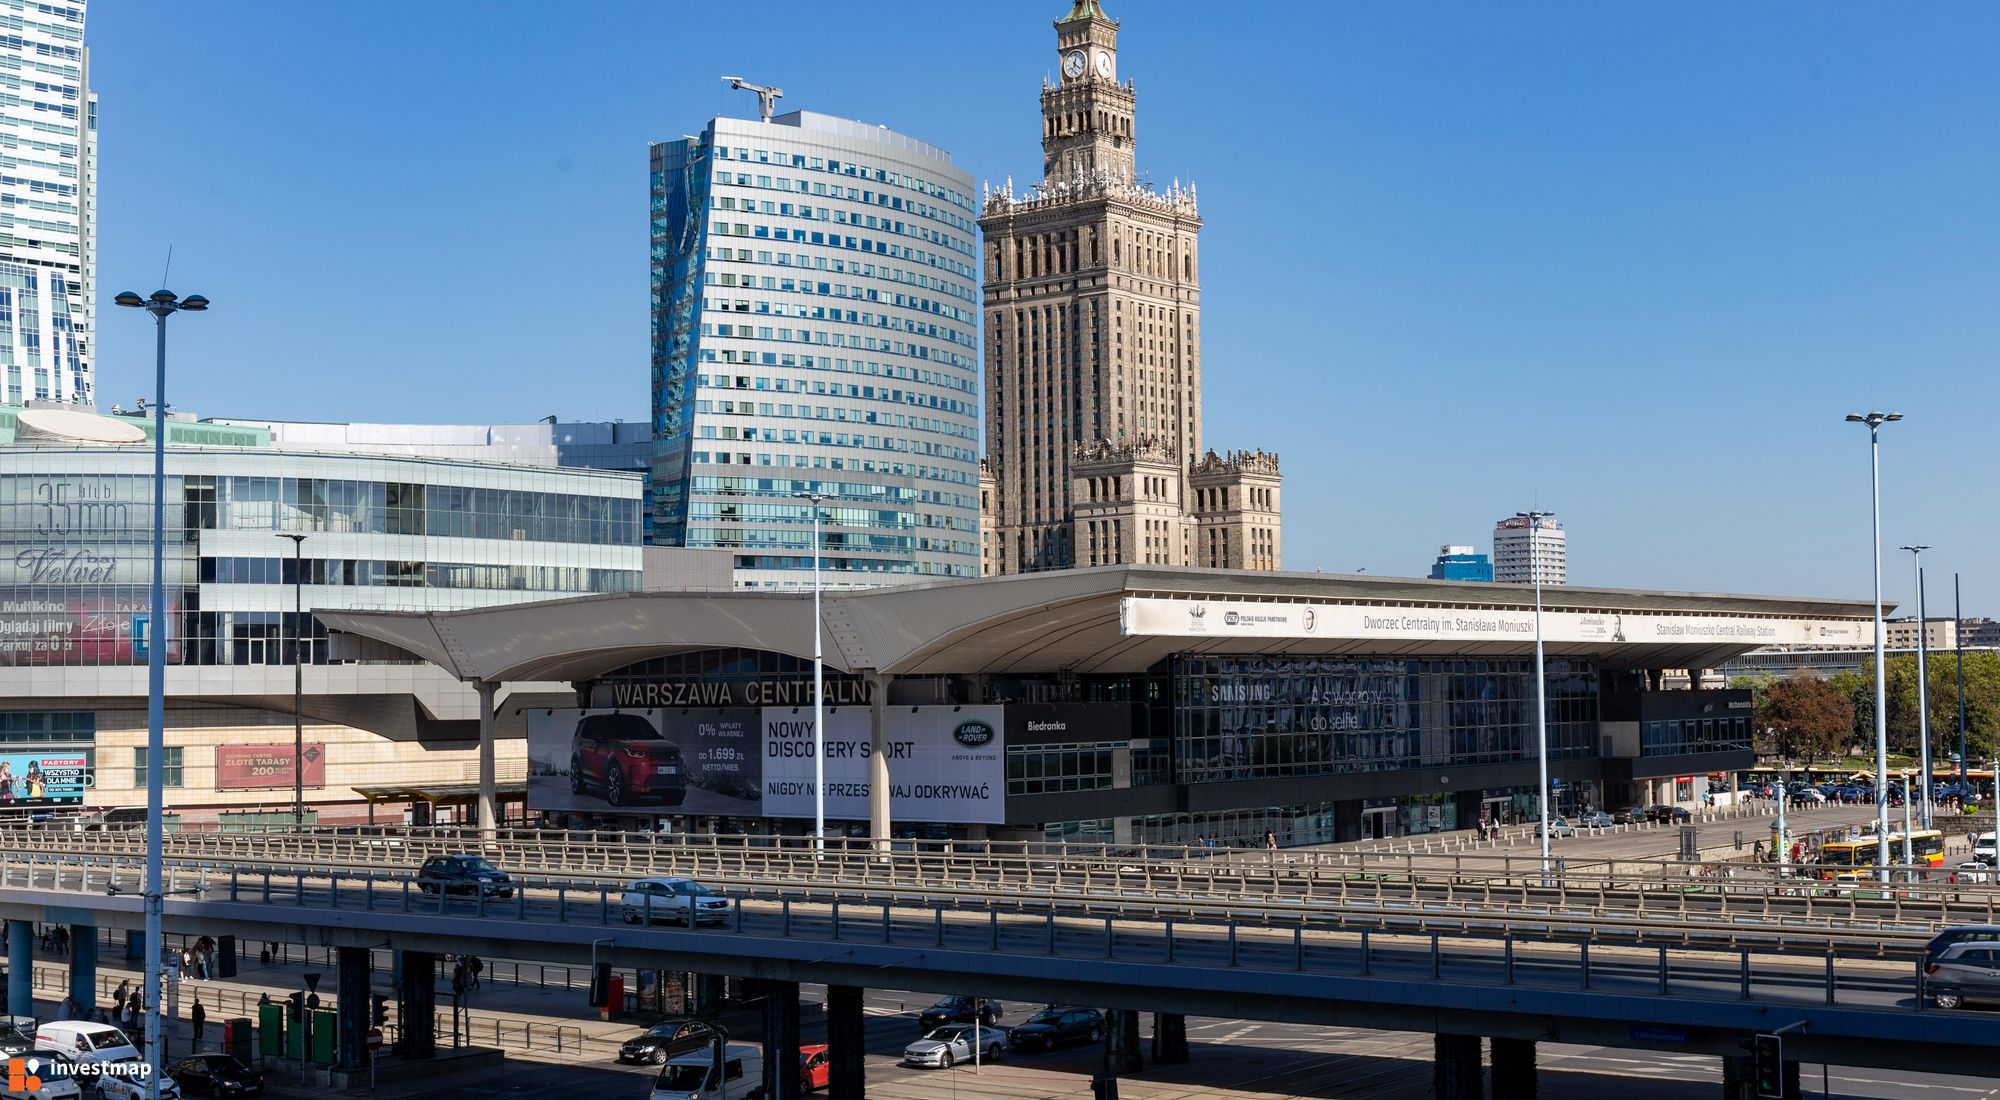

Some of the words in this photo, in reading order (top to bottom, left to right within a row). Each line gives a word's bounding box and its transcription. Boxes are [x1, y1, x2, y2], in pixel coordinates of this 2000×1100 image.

[16, 548, 117, 583] Velvet
[117, 603, 153, 612] TARAS
[43, 620, 73, 633] filmy
[1364, 616, 1399, 630] Dworzec
[1401, 617, 1439, 633] Centralny
[1442, 618, 1454, 631] im.
[1455, 618, 1496, 632] Stanisława
[1498, 620, 1534, 632] Moniuszki
[1656, 623, 1684, 635] Stanislaw
[1685, 624, 1714, 636] Moniuszko
[1715, 625, 1735, 636] Central
[1736, 626, 1755, 638] Railway
[1756, 627, 1776, 637] Station
[35, 641, 47, 651] za
[50, 634, 60, 651] 0
[615, 682, 732, 705] WARSZAWA
[745, 680, 872, 703] CENTRALN
[1211, 684, 1270, 702] SAMSUNG
[698, 724, 716, 736] 0%
[769, 722, 814, 738] NOWY
[961, 726, 981, 734] LAND
[1028, 721, 1066, 731] Biedronka
[962, 733, 988, 742] ROVER
[708, 748, 735, 760] 1.699
[769, 742, 856, 758] DISCOERY
[256, 758, 290, 766] TARASY
[252, 767, 274, 776] 200
[769, 783, 804, 798] NIGDY
[914, 783, 989, 800] ODKRYWAĆ
